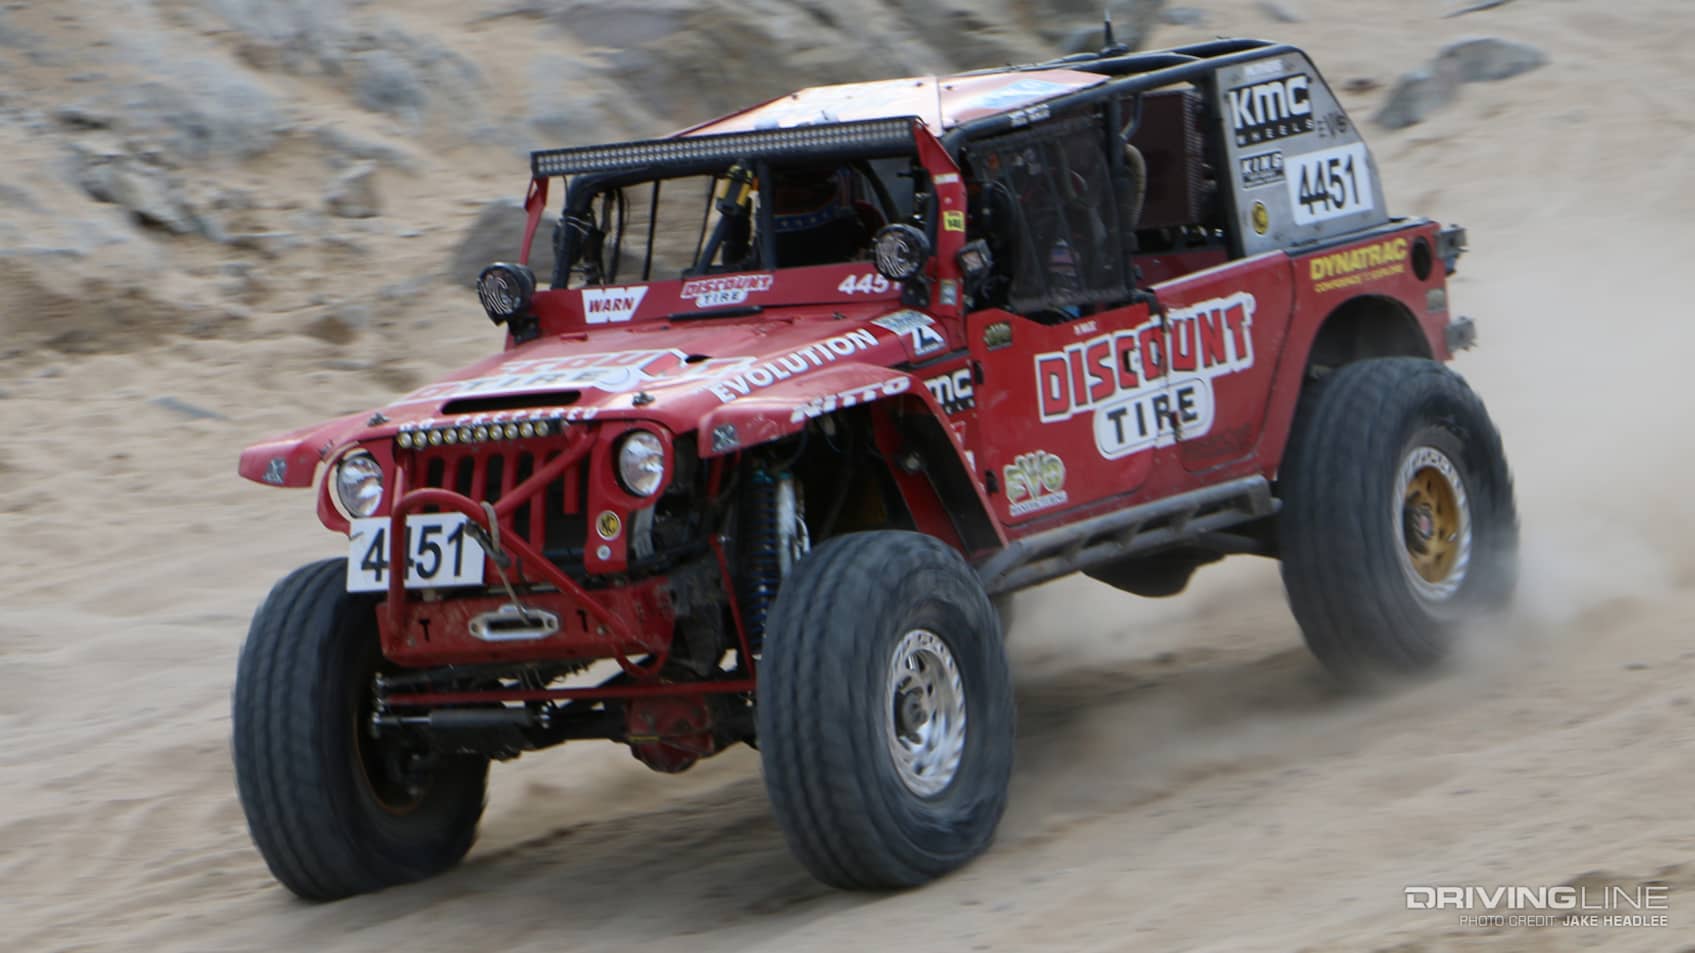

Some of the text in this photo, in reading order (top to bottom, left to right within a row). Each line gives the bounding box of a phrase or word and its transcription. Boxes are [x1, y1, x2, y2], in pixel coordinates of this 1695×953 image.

[1300, 153, 1360, 217] 4451
[1310, 237, 1408, 281] DYNATRAC
[589, 296, 635, 313] WARN
[683, 274, 773, 298] DISCOUNT
[702, 291, 740, 305] TIRE
[709, 328, 880, 404] EVOLUTION
[1035, 296, 1253, 421] DISCOUNT
[790, 386, 911, 424] NITTO
[1106, 386, 1199, 445] TIRE
